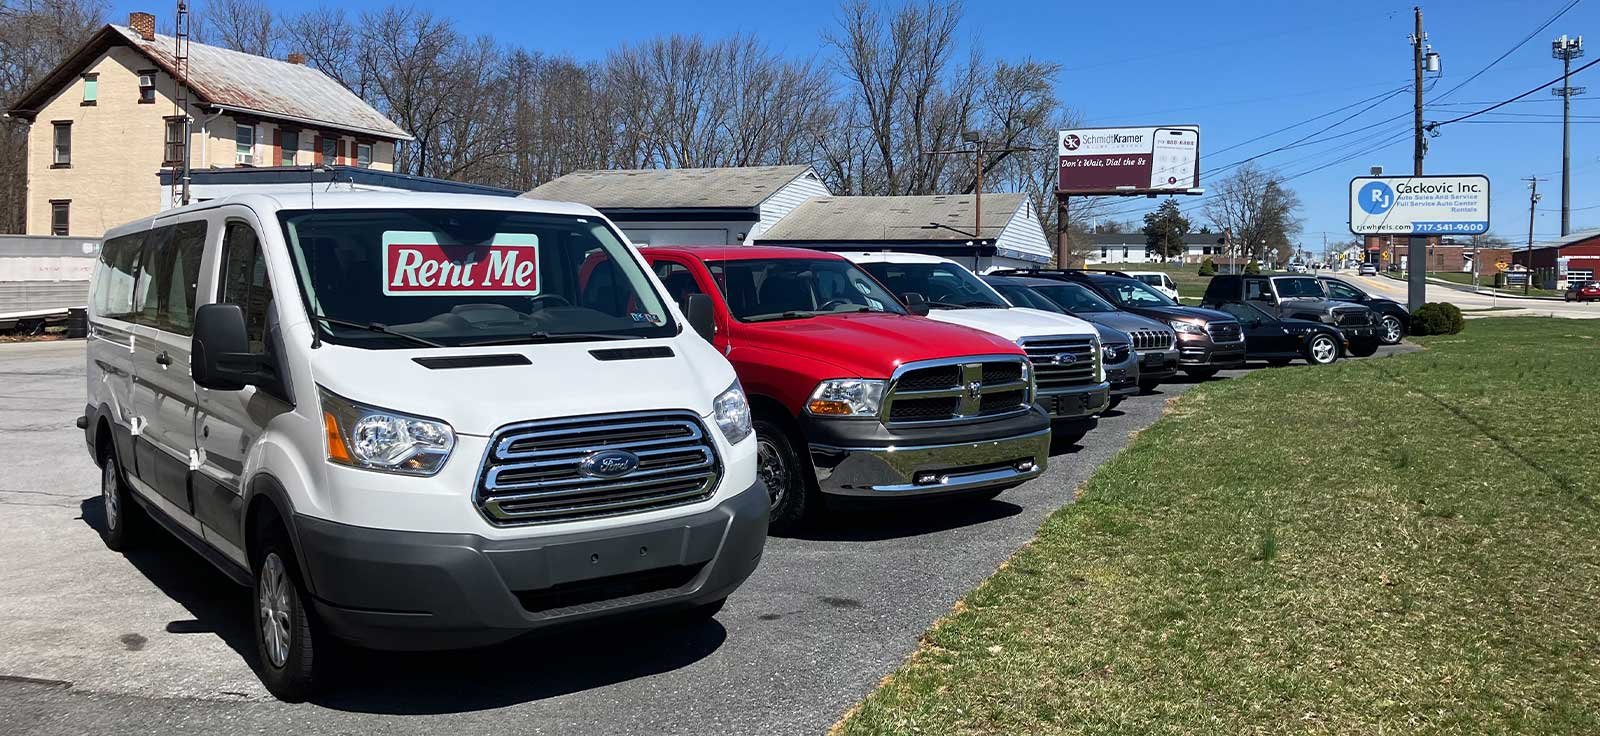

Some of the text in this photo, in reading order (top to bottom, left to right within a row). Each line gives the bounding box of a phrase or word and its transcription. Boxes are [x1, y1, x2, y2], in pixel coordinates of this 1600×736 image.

[1061, 159, 1082, 167] Don't
[1083, 159, 1104, 167] Wait,
[1106, 158, 1121, 166] Dial
[1123, 158, 1135, 166] the
[1396, 181, 1482, 194] Cackovic Inc.
[1450, 192, 1478, 200] Service
[1357, 223, 1484, 232] rjcwheels.com 717-541-9600
[390, 249, 534, 287] Rent Me
[600, 457, 630, 471] Ford
